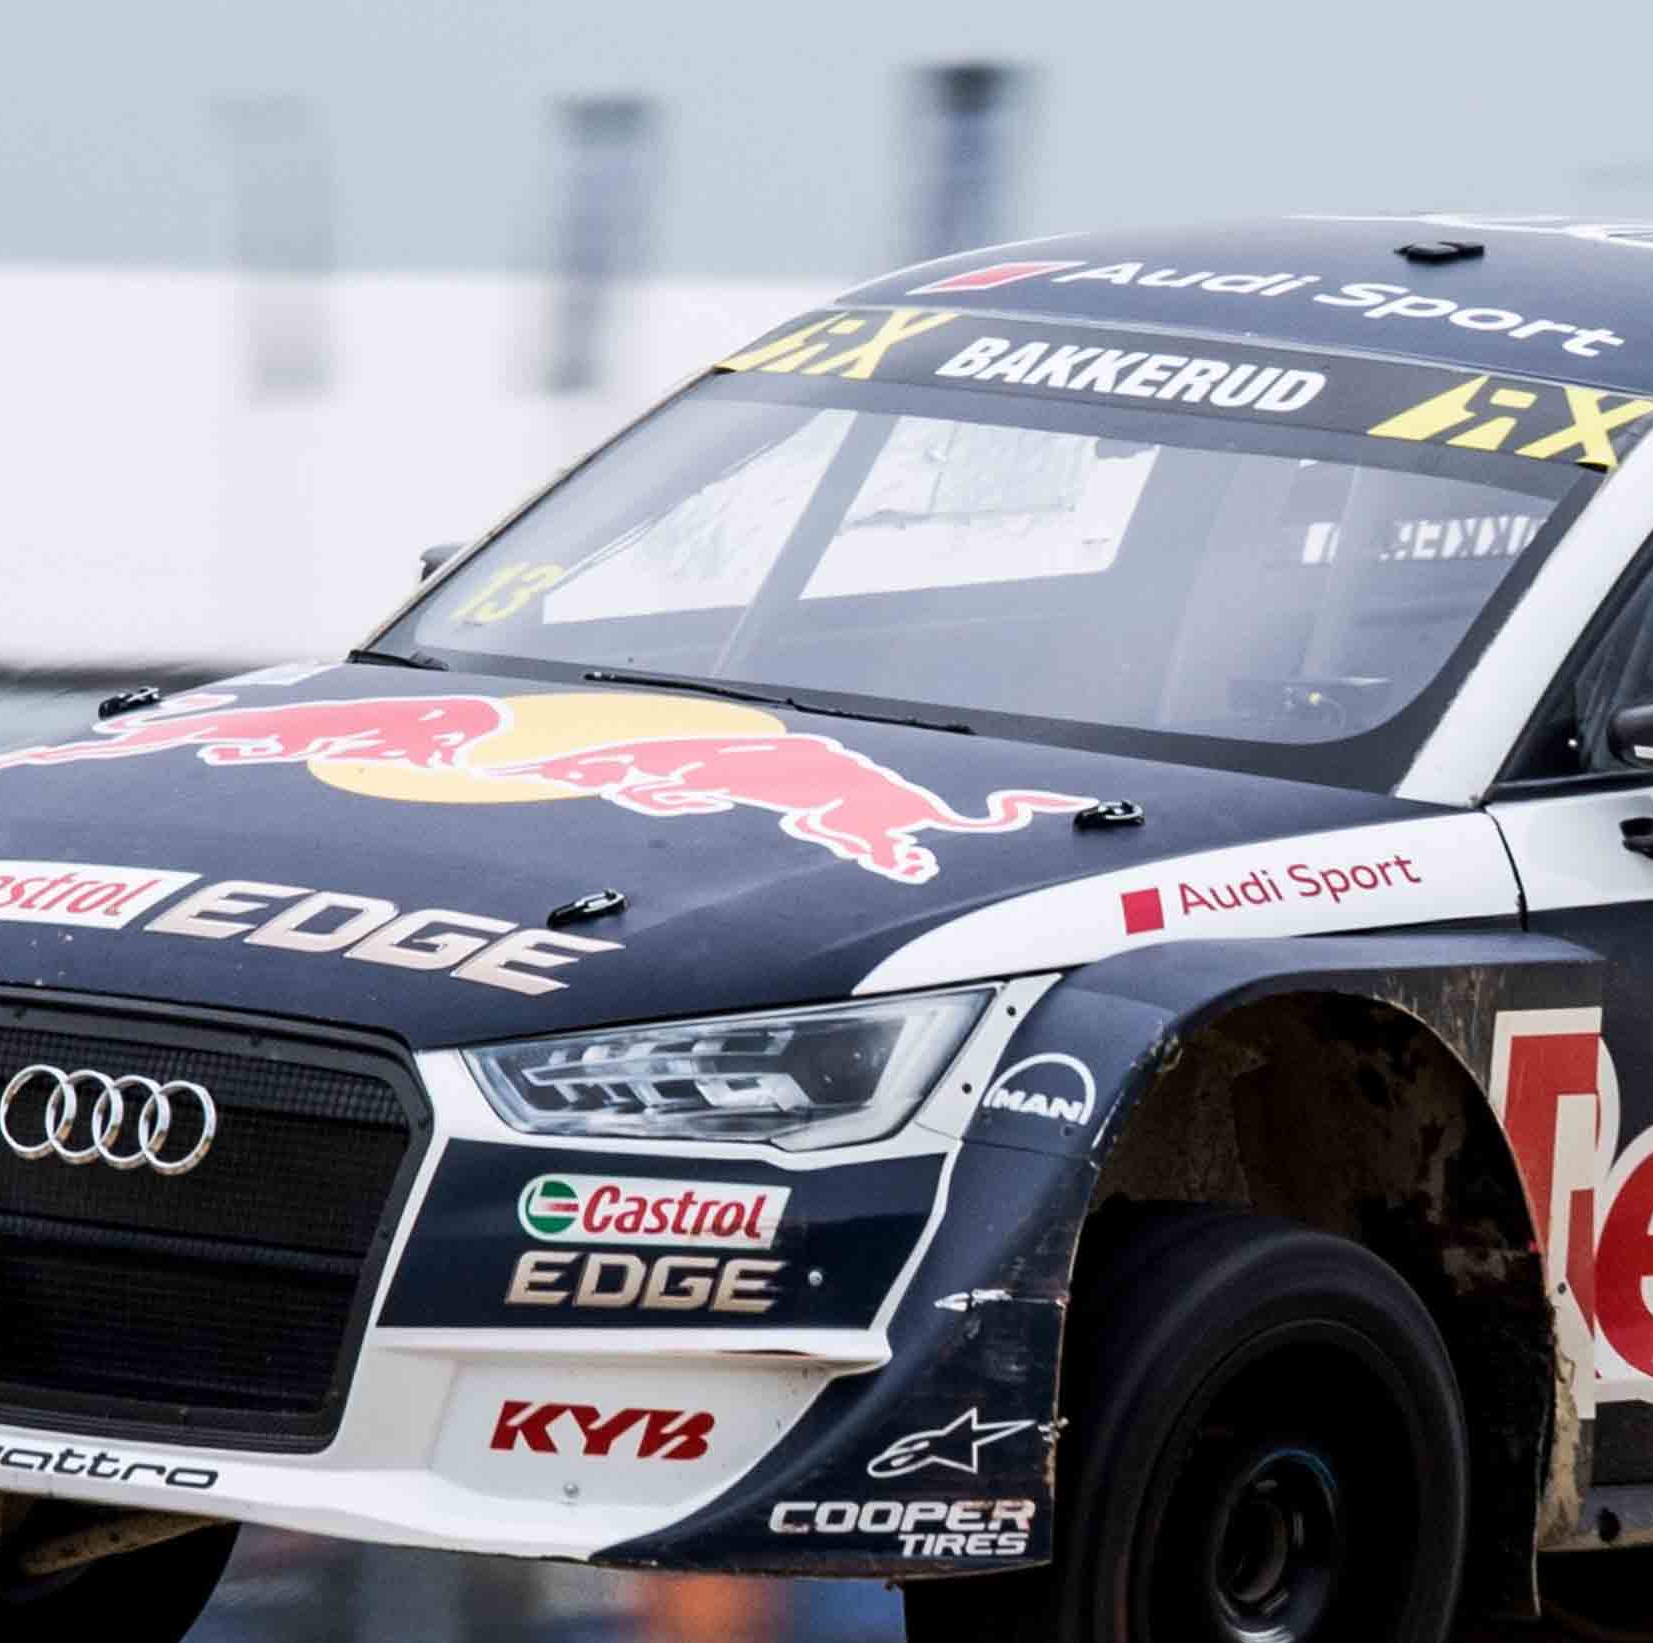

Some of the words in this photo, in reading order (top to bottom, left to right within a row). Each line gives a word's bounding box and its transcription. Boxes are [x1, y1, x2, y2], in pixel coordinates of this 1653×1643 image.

[1061, 260, 1296, 298] Audi
[1313, 282, 1626, 362] Sport
[935, 337, 1326, 413] BAKKERUD
[1178, 868, 1283, 916] Audi
[1293, 852, 1424, 906] Sport
[146, 878, 625, 994] EDGE
[991, 1086, 1084, 1123] MAN
[582, 1184, 765, 1240] Castrol
[504, 1250, 788, 1314] EDGE
[489, 1400, 716, 1461] KYB
[768, 1499, 1036, 1534] COOPER
[897, 1531, 1030, 1558] TIRES
